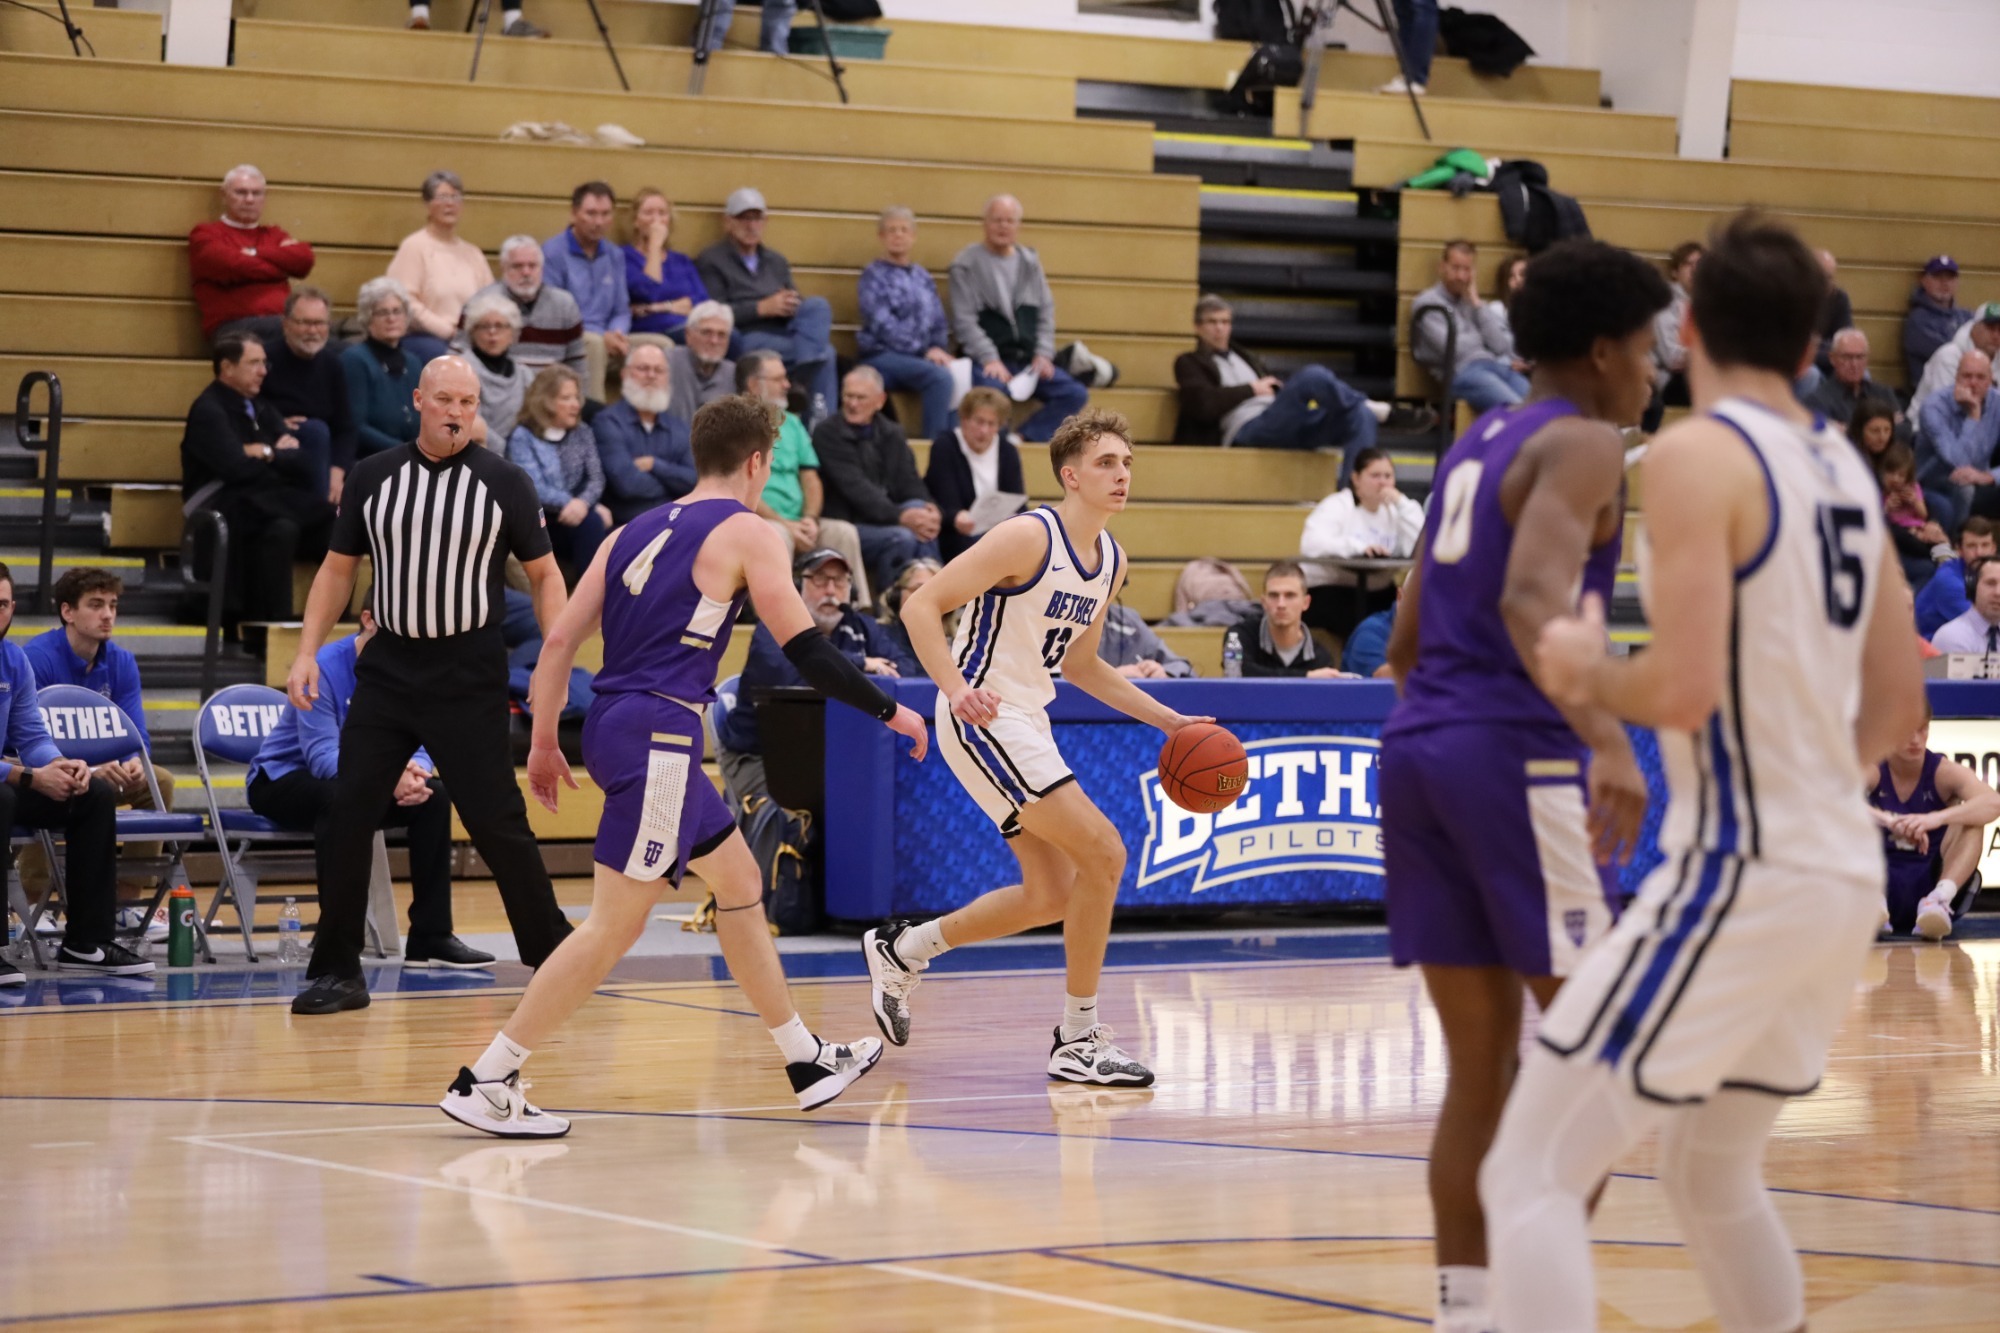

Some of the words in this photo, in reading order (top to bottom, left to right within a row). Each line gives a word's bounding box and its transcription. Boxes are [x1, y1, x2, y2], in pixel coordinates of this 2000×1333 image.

[622, 528, 673, 596] 4
[1816, 503, 1866, 630] 15
[1043, 590, 1098, 627] BETHEL
[1041, 627, 1073, 669] 13
[210, 704, 285, 737] BETH
[1153, 750, 1383, 866] BETH
